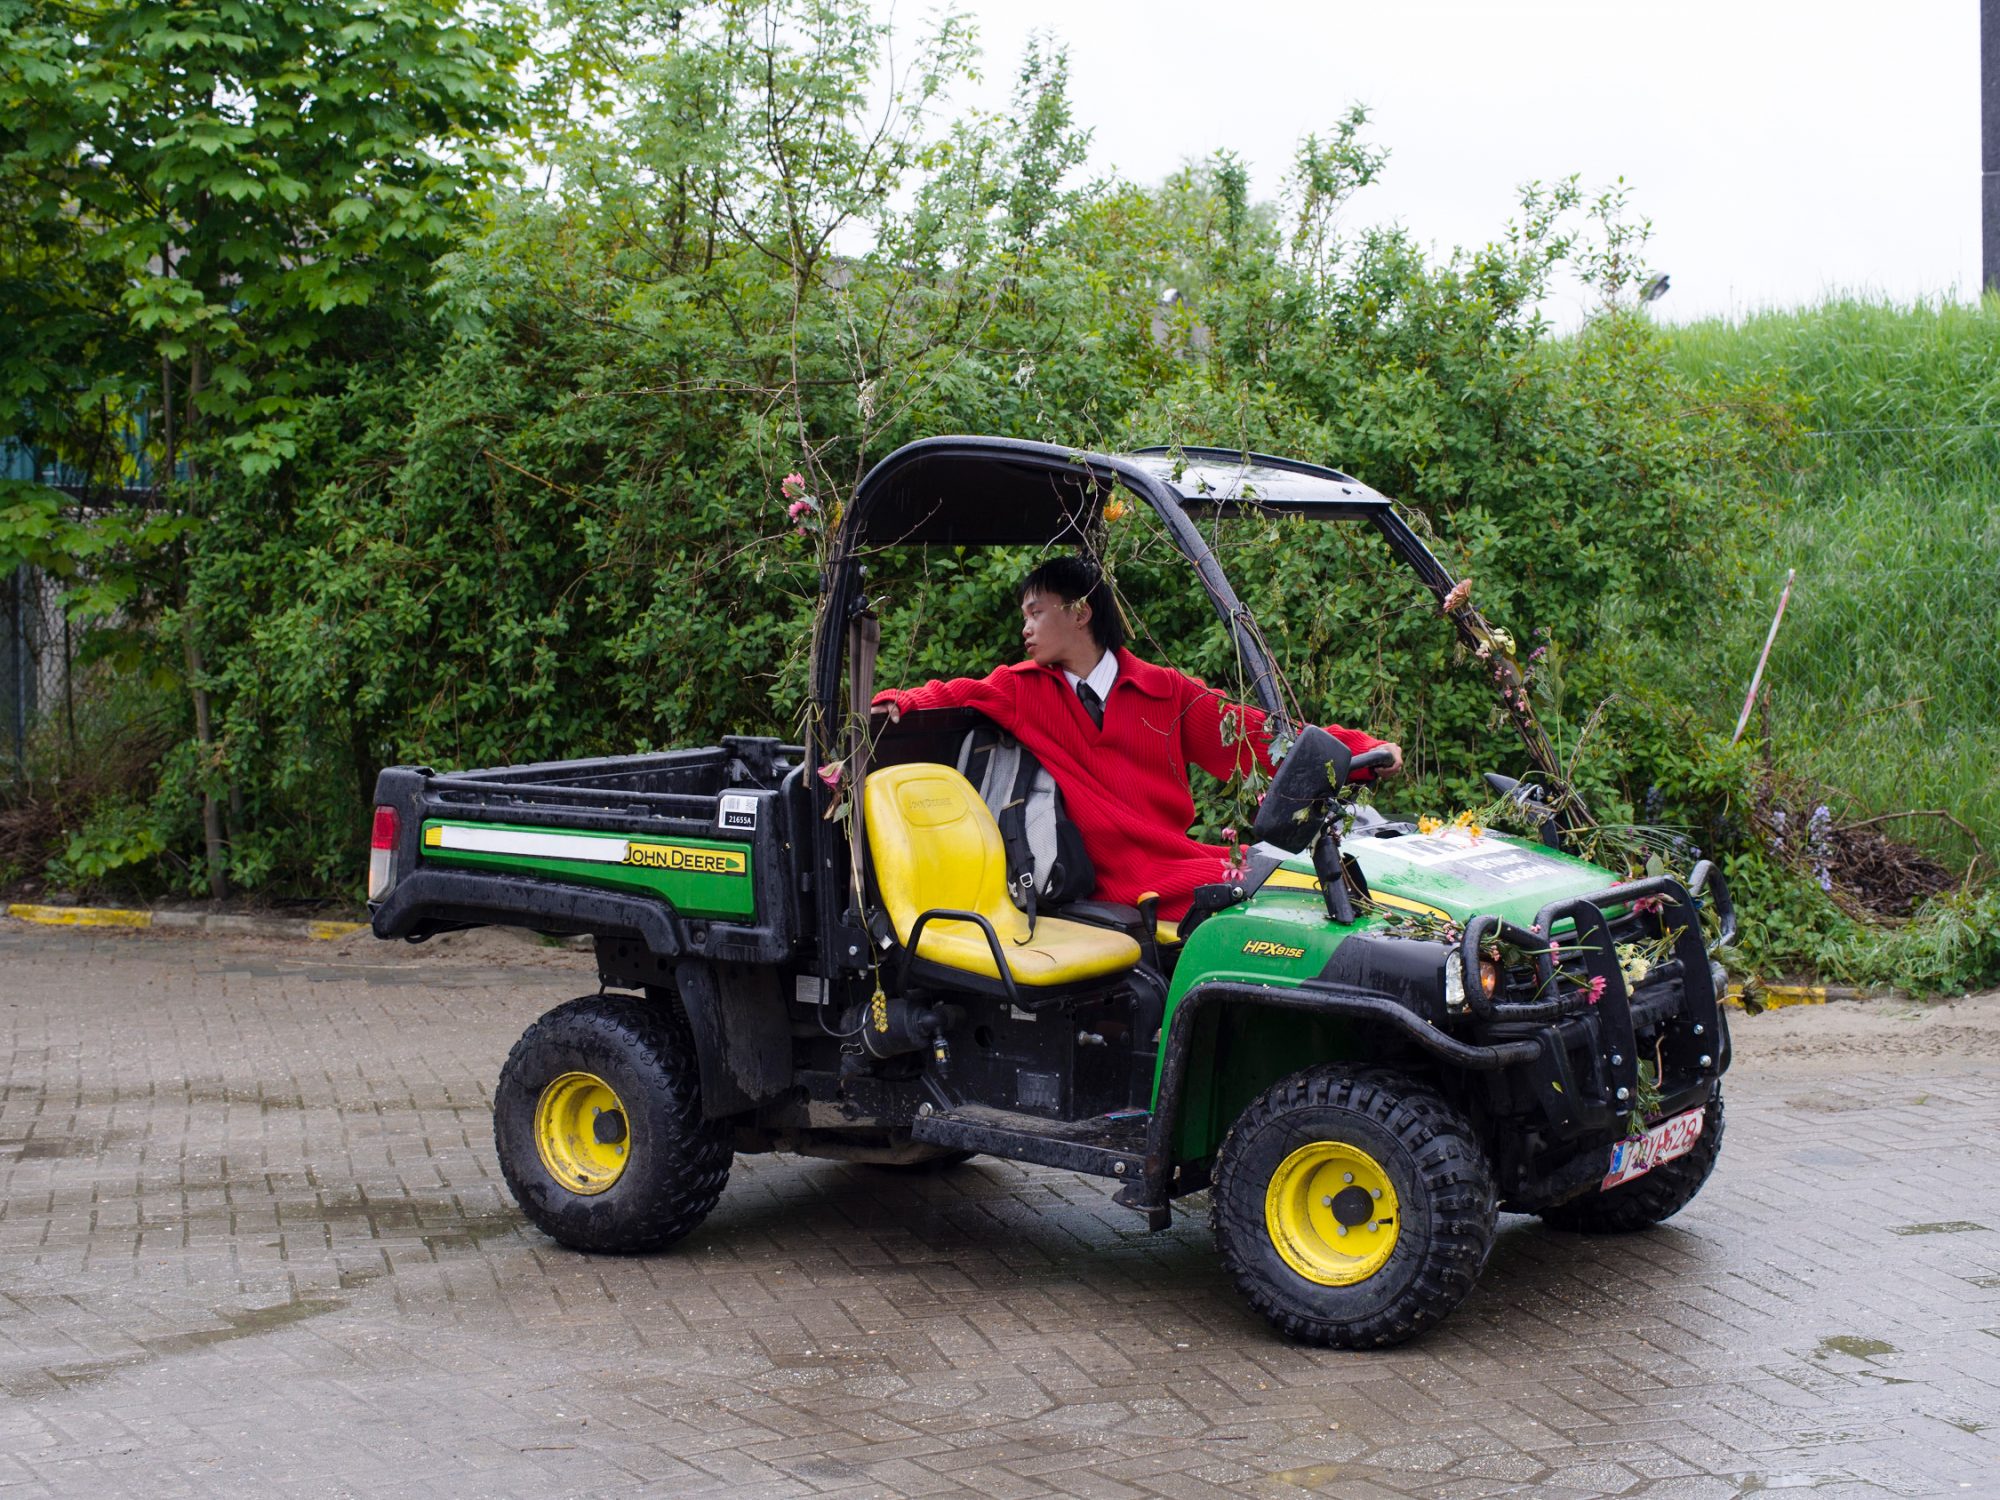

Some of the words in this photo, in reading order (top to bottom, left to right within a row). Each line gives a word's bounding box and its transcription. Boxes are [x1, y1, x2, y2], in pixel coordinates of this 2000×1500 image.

[624, 846, 667, 866] JOHN
[671, 850, 726, 870] DEERE
[1243, 940, 1305, 958] HPX815E
